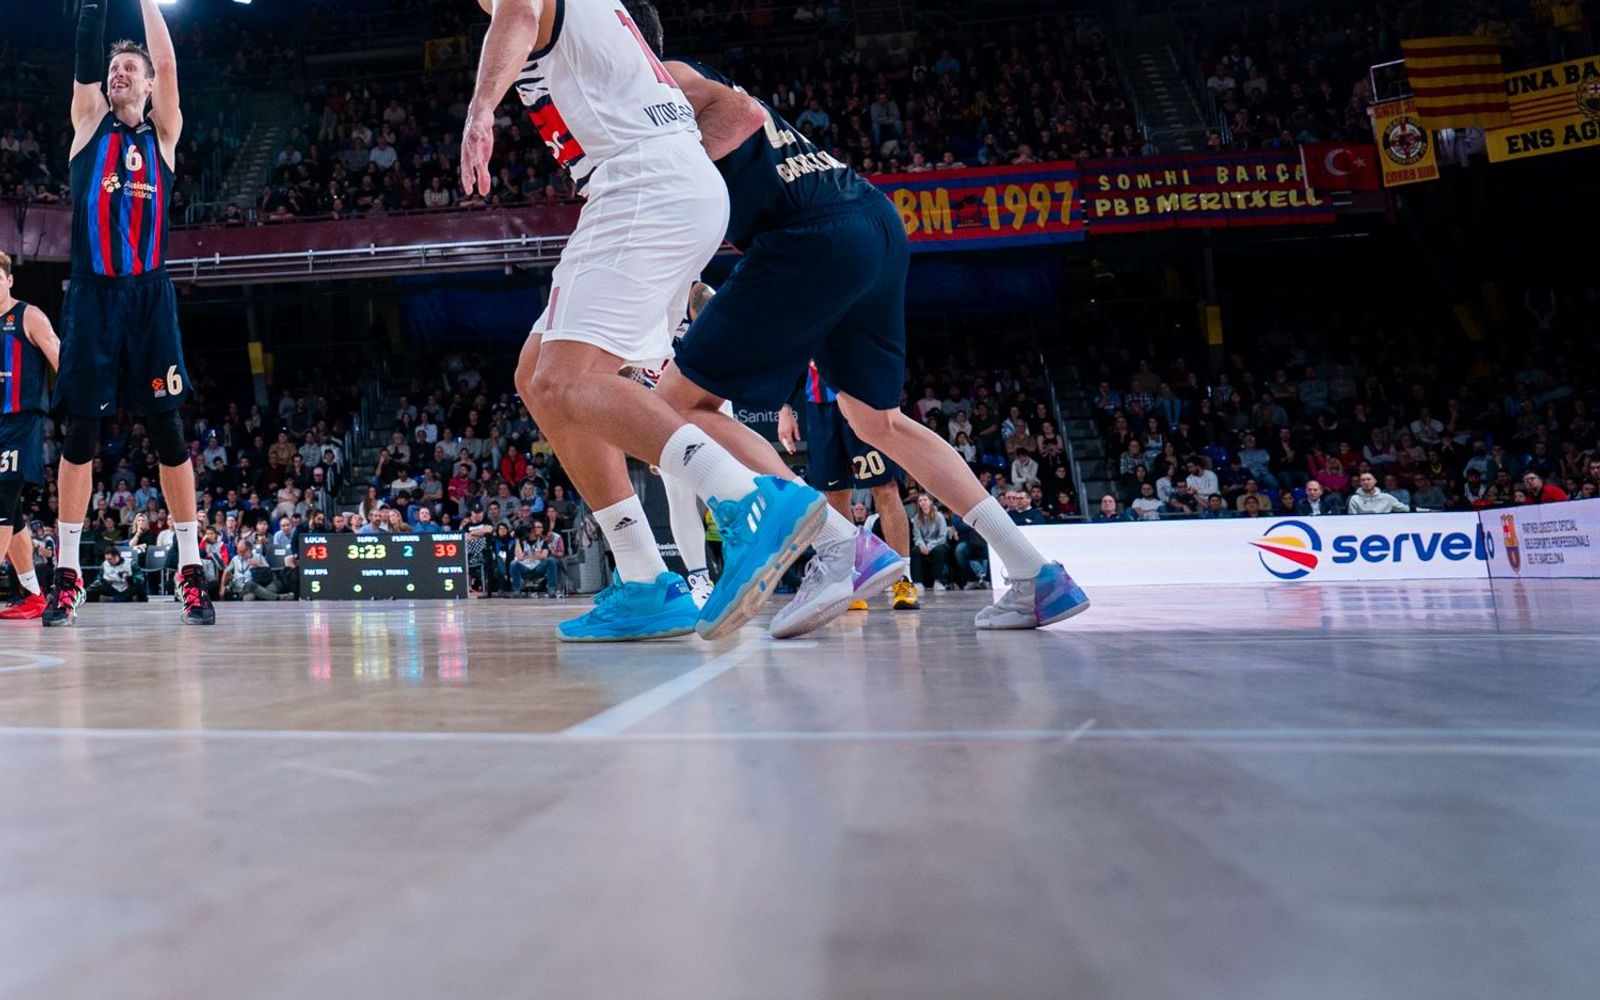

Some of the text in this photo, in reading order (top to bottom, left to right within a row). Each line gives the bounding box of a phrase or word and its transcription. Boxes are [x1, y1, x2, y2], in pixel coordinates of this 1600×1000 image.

[1504, 61, 1600, 96] UNA BA
[1506, 120, 1600, 154] ENS AG
[126, 144, 142, 171] 6
[1098, 168, 1190, 191] SOM-HI
[982, 181, 1073, 231] 1997
[1156, 187, 1324, 213] MERITXELL
[166, 364, 183, 396] 6
[0, 450, 18, 472] 31
[853, 450, 886, 480] 20
[306, 543, 457, 560] 43 3:23 2 39
[311, 579, 454, 593] 5 5
